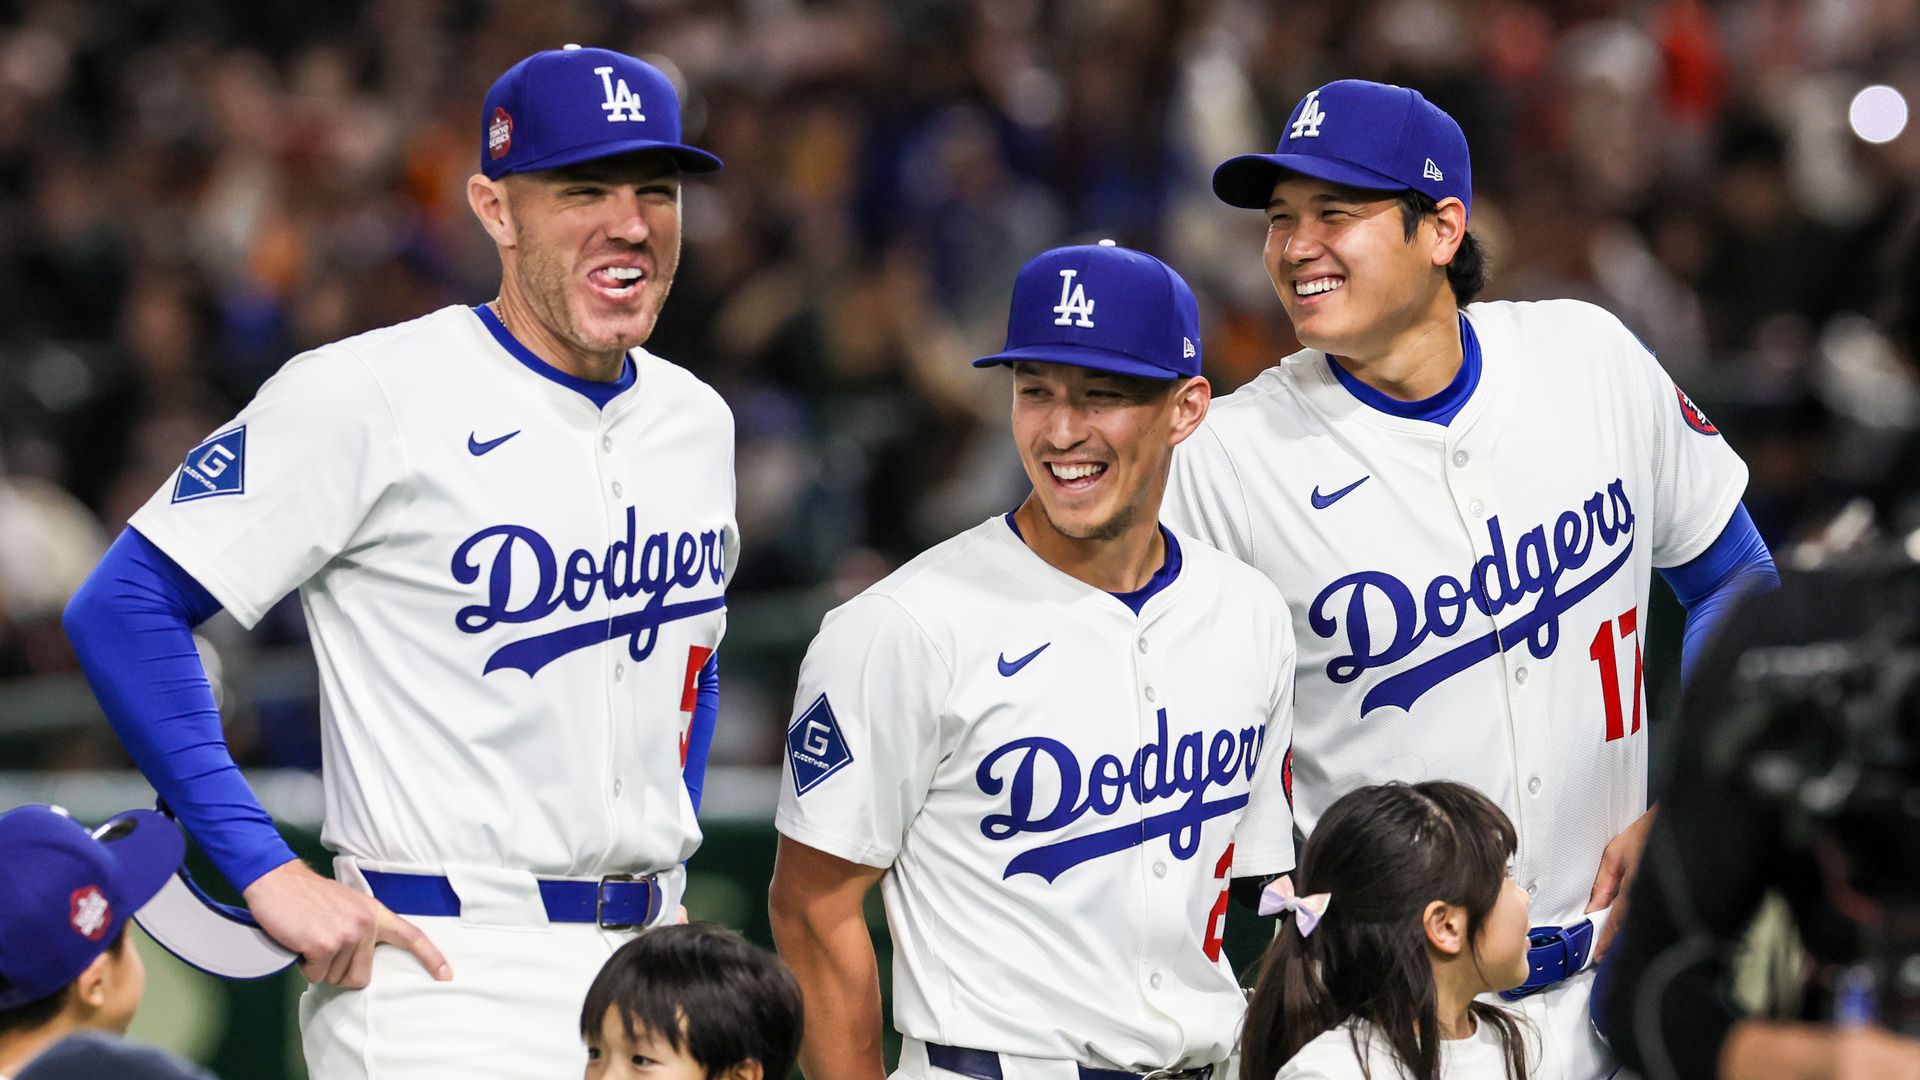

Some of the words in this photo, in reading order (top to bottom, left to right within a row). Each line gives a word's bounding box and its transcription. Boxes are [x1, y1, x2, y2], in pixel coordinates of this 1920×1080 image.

[594, 66, 646, 122] LA
[1290, 90, 1326, 139] LA
[1053, 269, 1095, 328] LA
[196, 443, 236, 478] G
[1309, 477, 1635, 684] Dodgers
[1589, 605, 1643, 742] 17
[803, 720, 831, 756] G
